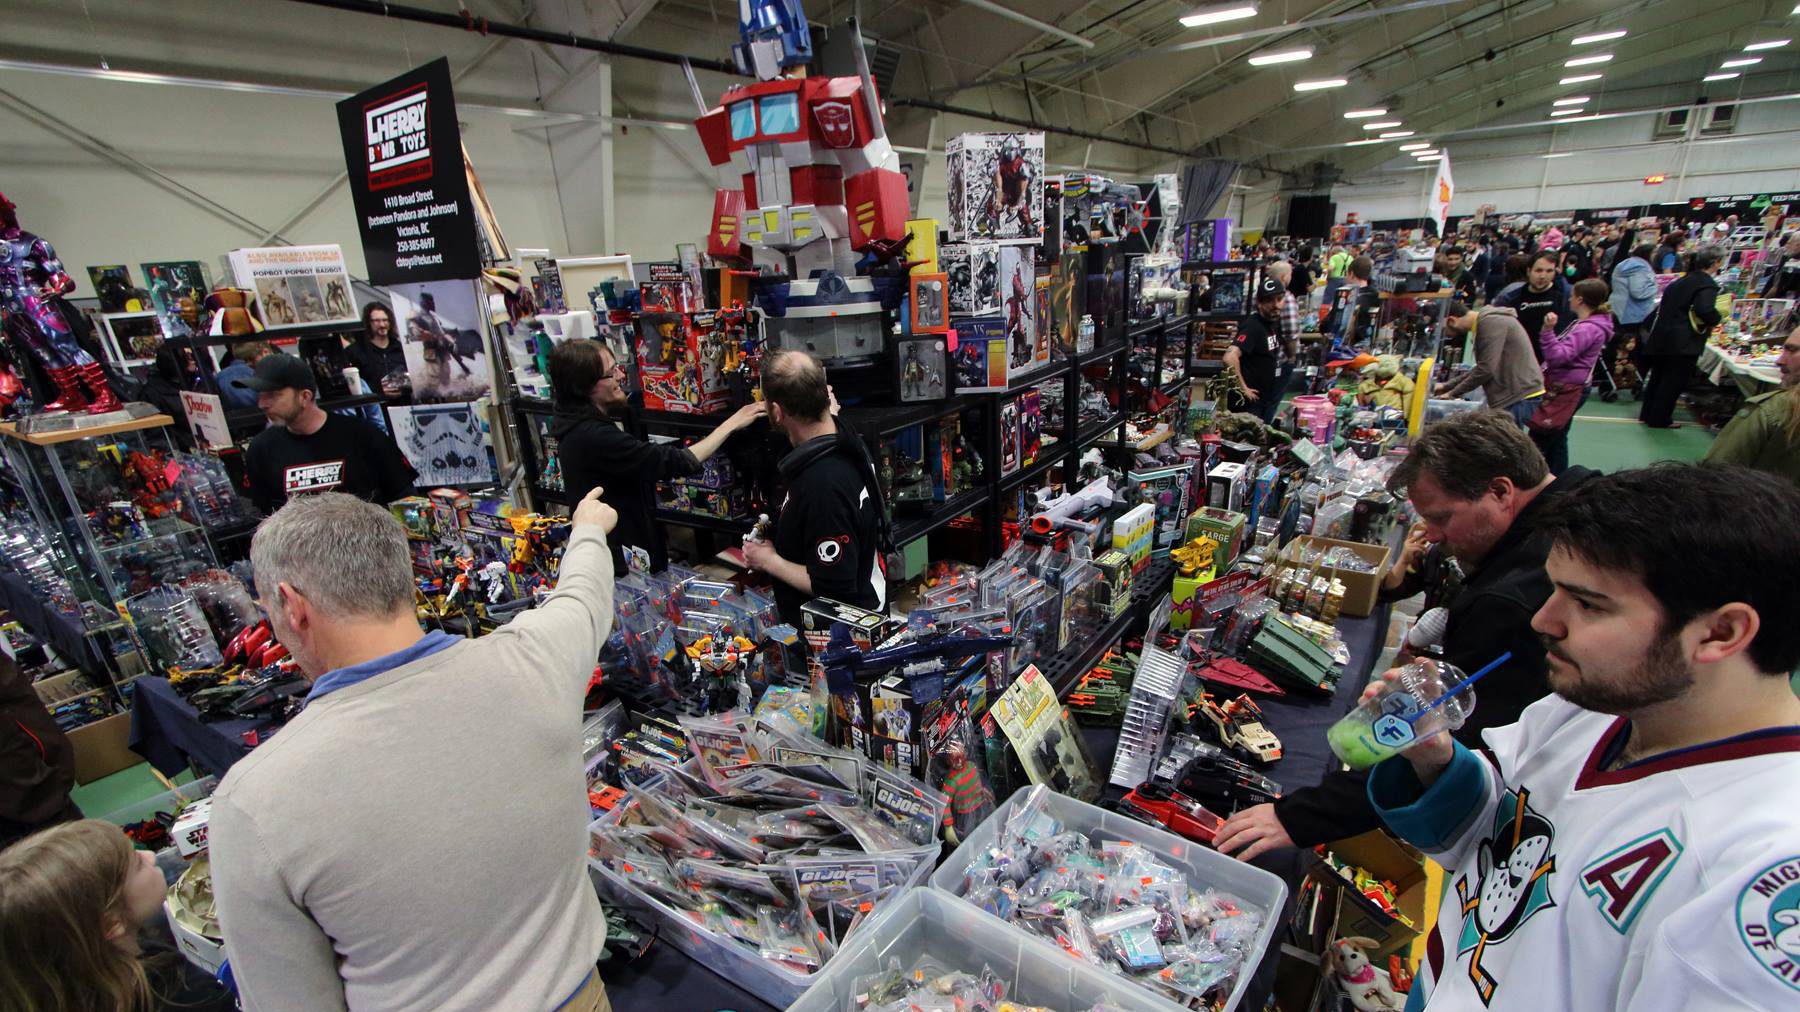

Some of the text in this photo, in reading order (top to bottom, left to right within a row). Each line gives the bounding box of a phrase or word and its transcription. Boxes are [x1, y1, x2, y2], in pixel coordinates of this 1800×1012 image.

[366, 98, 427, 146] CHERRY
[399, 131, 426, 153] TOYS
[384, 189, 434, 208] 1410 Broad Street
[367, 200, 459, 229] (between Pandora and Johnson)
[397, 222, 430, 237] Victoria, BC
[286, 464, 341, 482] CHERRY
[1200, 529, 1231, 543] SARGE
[1581, 832, 1680, 928] A
[1752, 860, 1800, 898] MIG
[1745, 924, 1777, 951] OF
